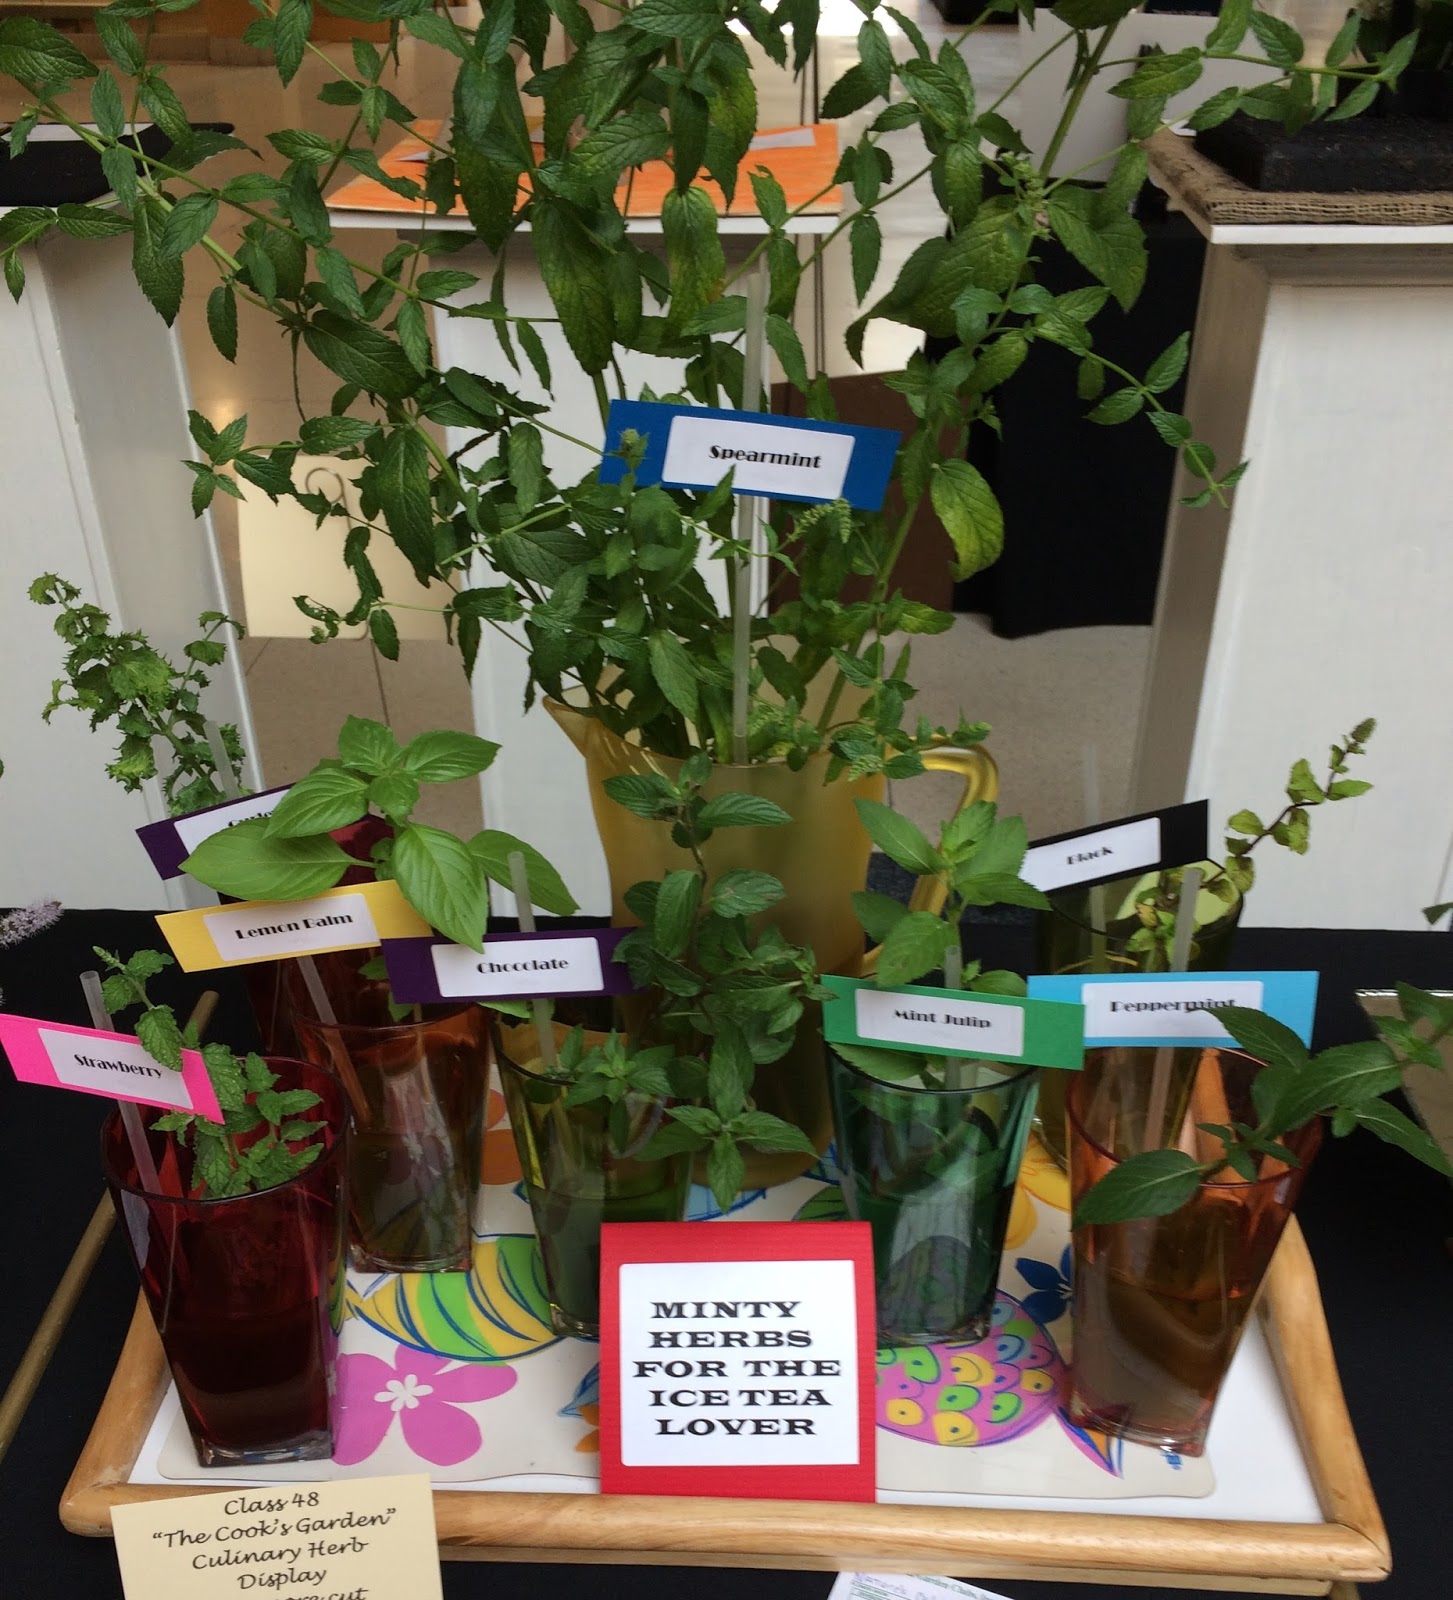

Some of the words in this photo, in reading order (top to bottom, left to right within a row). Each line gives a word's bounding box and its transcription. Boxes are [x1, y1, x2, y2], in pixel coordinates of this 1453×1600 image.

[709, 445, 822, 469] Spearmint
[1066, 846, 1114, 865] Black
[235, 921, 300, 940] Lemon
[302, 913, 354, 930] Balm
[477, 958, 569, 974] Chocolate
[894, 1009, 936, 1023] Mint
[943, 1013, 992, 1029] Julip
[73, 1053, 162, 1079] Strawberry
[650, 1301, 802, 1319] MINTY
[647, 1330, 813, 1349] HERBS
[632, 1360, 728, 1378] FOR
[744, 1360, 841, 1377] THE
[648, 1389, 730, 1407] ICE
[738, 1389, 833, 1407] TEA
[655, 1418, 817, 1436] LOVER
[224, 1497, 288, 1516] Class
[291, 1491, 320, 1508] 48
[152, 1530, 212, 1548] “The
[215, 1518, 292, 1542] Cook’s
[295, 1508, 397, 1533] Garden”
[192, 1547, 301, 1570] Culinary
[307, 1537, 369, 1558] Herb
[237, 1568, 327, 1591] Display
[328, 1588, 369, 1600] cut
